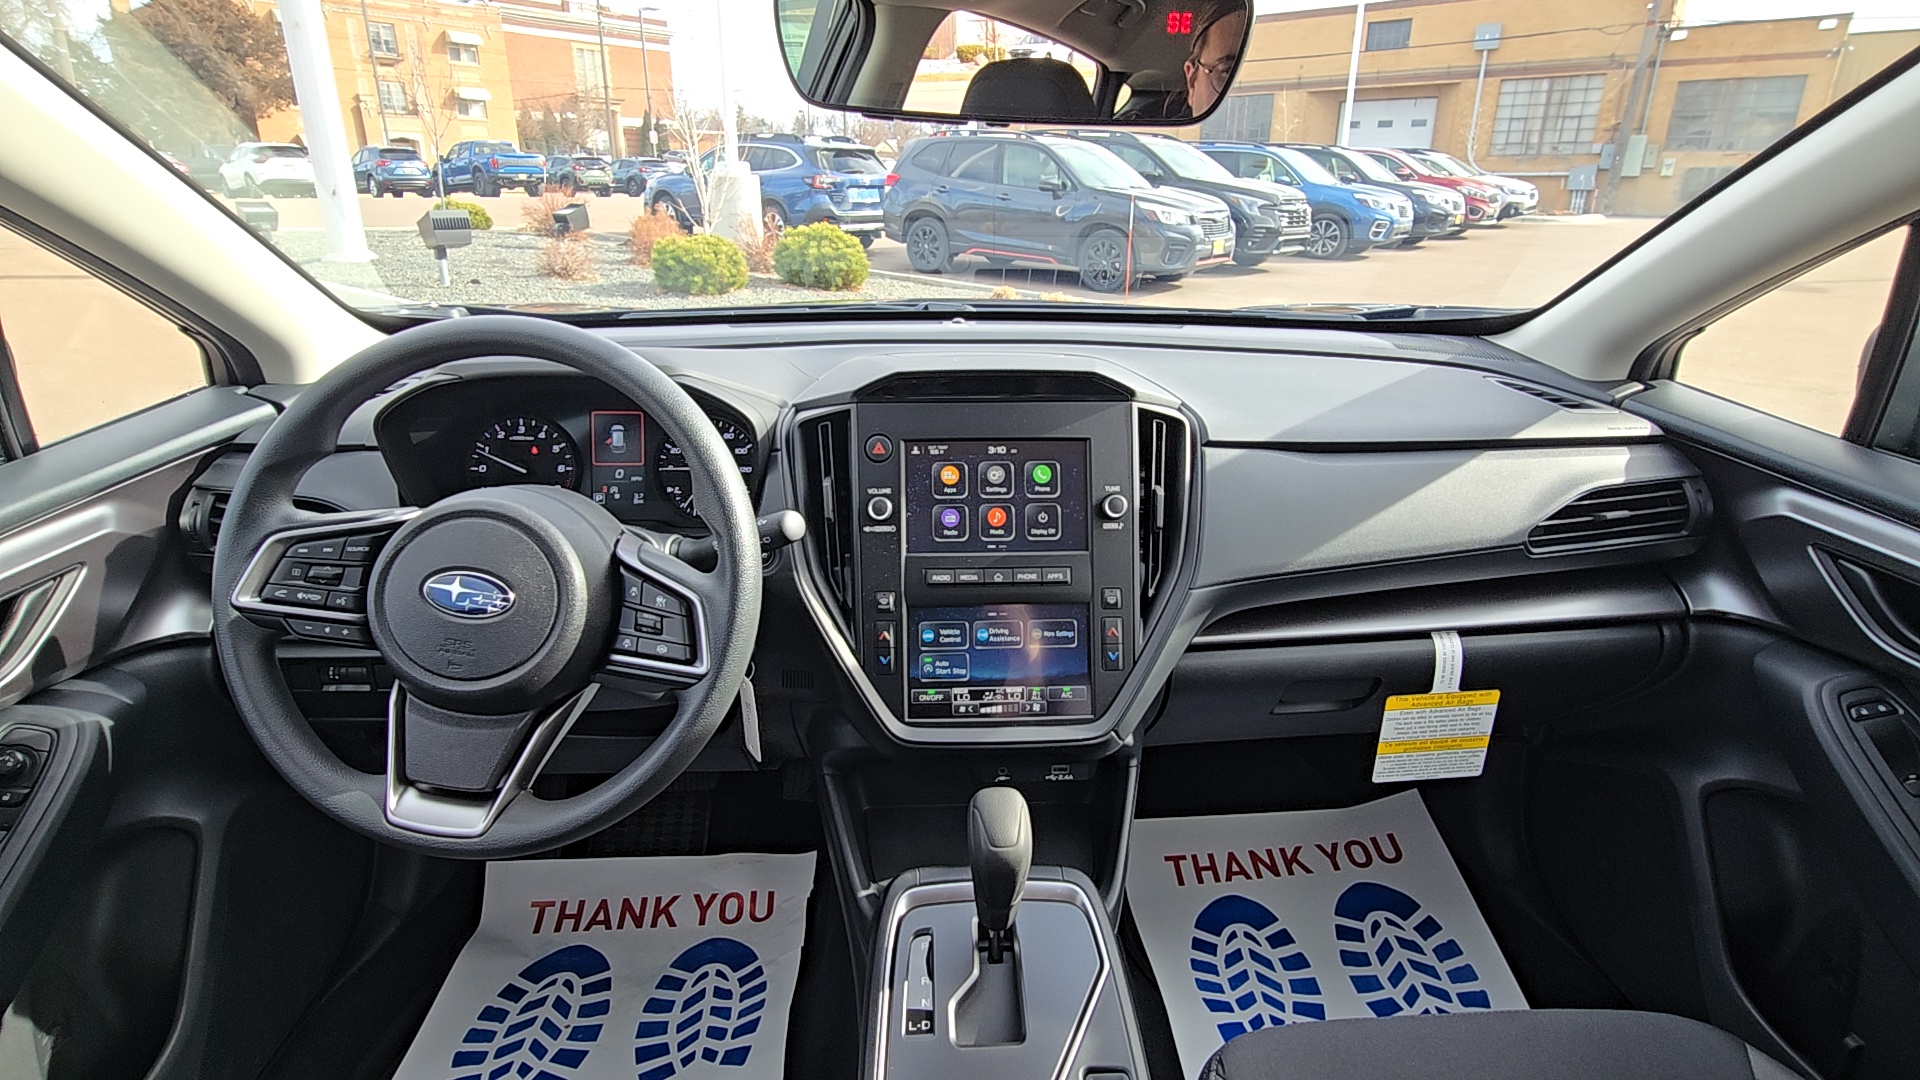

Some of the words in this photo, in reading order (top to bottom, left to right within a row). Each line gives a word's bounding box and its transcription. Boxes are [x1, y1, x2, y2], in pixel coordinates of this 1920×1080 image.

[517, 425, 526, 434] 3
[496, 431, 506, 439] 2
[537, 431, 546, 439] 4
[552, 444, 560, 453] 5
[669, 447, 682, 455] 20
[987, 445, 1007, 455] 3:10
[479, 464, 487, 473] 0
[557, 464, 566, 473] 6
[615, 468, 625, 479] 0
[866, 487, 892, 495] VOLUME
[988, 627, 1009, 636] Driving
[1055, 630, 1075, 638] Settings
[952, 667, 967, 675] Stop
[957, 693, 971, 701] LO
[1007, 692, 1021, 700] LO
[1411, 694, 1436, 702] Vehicle
[1445, 692, 1477, 701] Equipped
[1410, 700, 1443, 708] Advanced
[1456, 698, 1474, 706] Bags
[1163, 844, 1315, 888] THANK
[1313, 832, 1404, 872] YOU
[530, 893, 682, 935] THANK
[692, 889, 776, 927] YOU
[921, 976, 930, 985] R
[921, 999, 930, 1008] N
